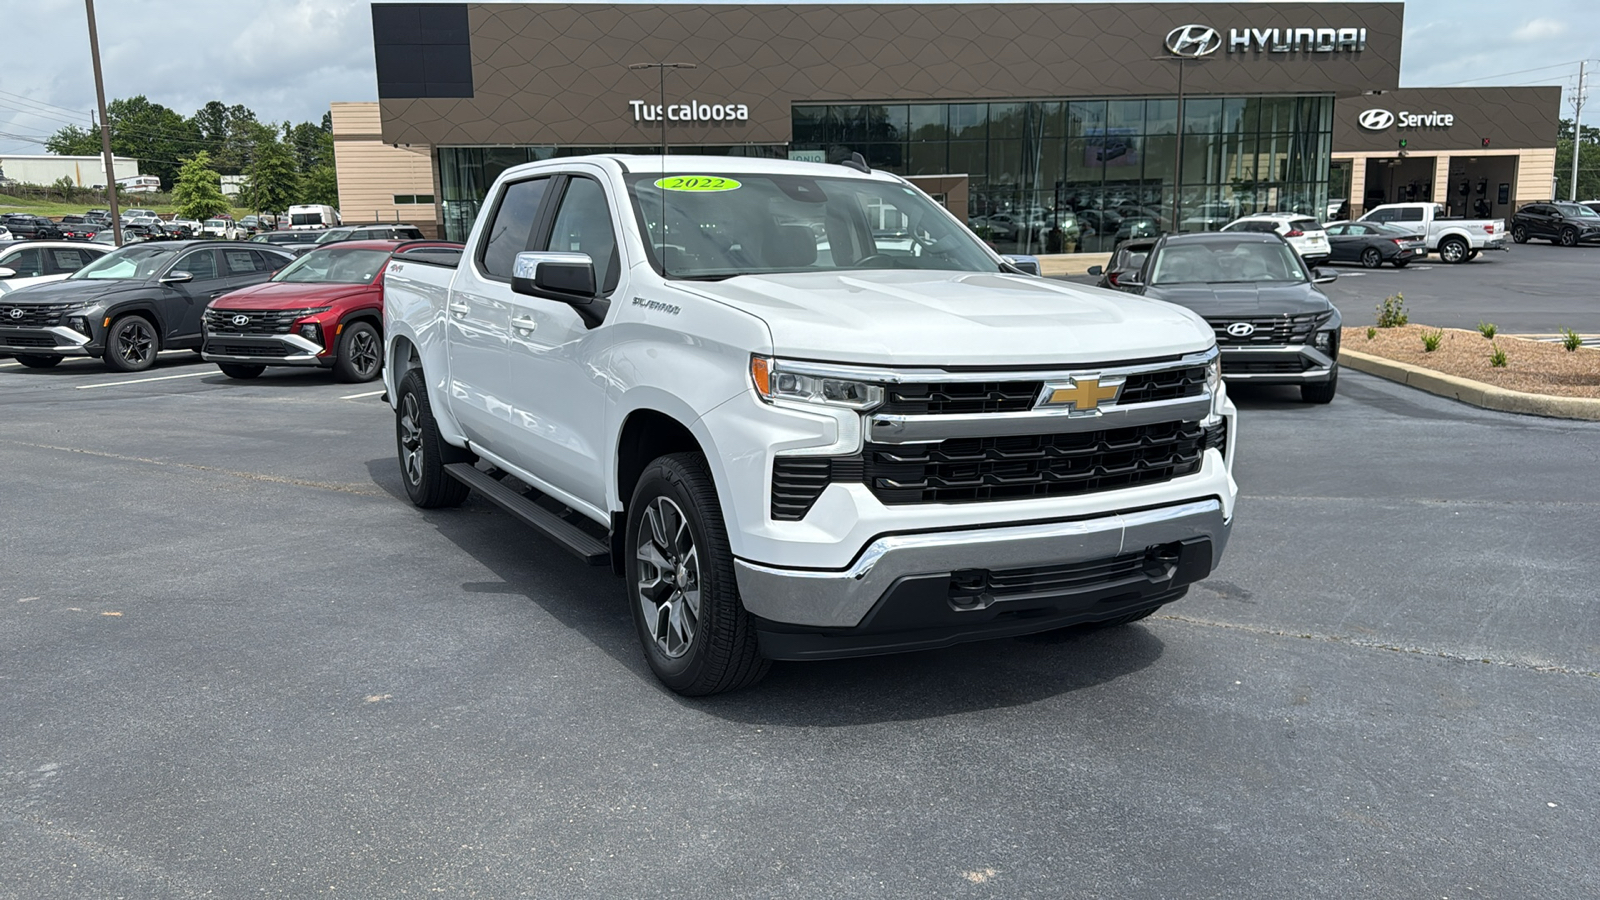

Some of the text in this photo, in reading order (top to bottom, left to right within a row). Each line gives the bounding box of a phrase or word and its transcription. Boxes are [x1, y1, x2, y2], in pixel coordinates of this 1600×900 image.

[1230, 28, 1367, 52] HYUNDAI
[629, 100, 749, 121] Tuscaloosa
[1398, 111, 1454, 127] Service
[670, 178, 725, 188] 2022
